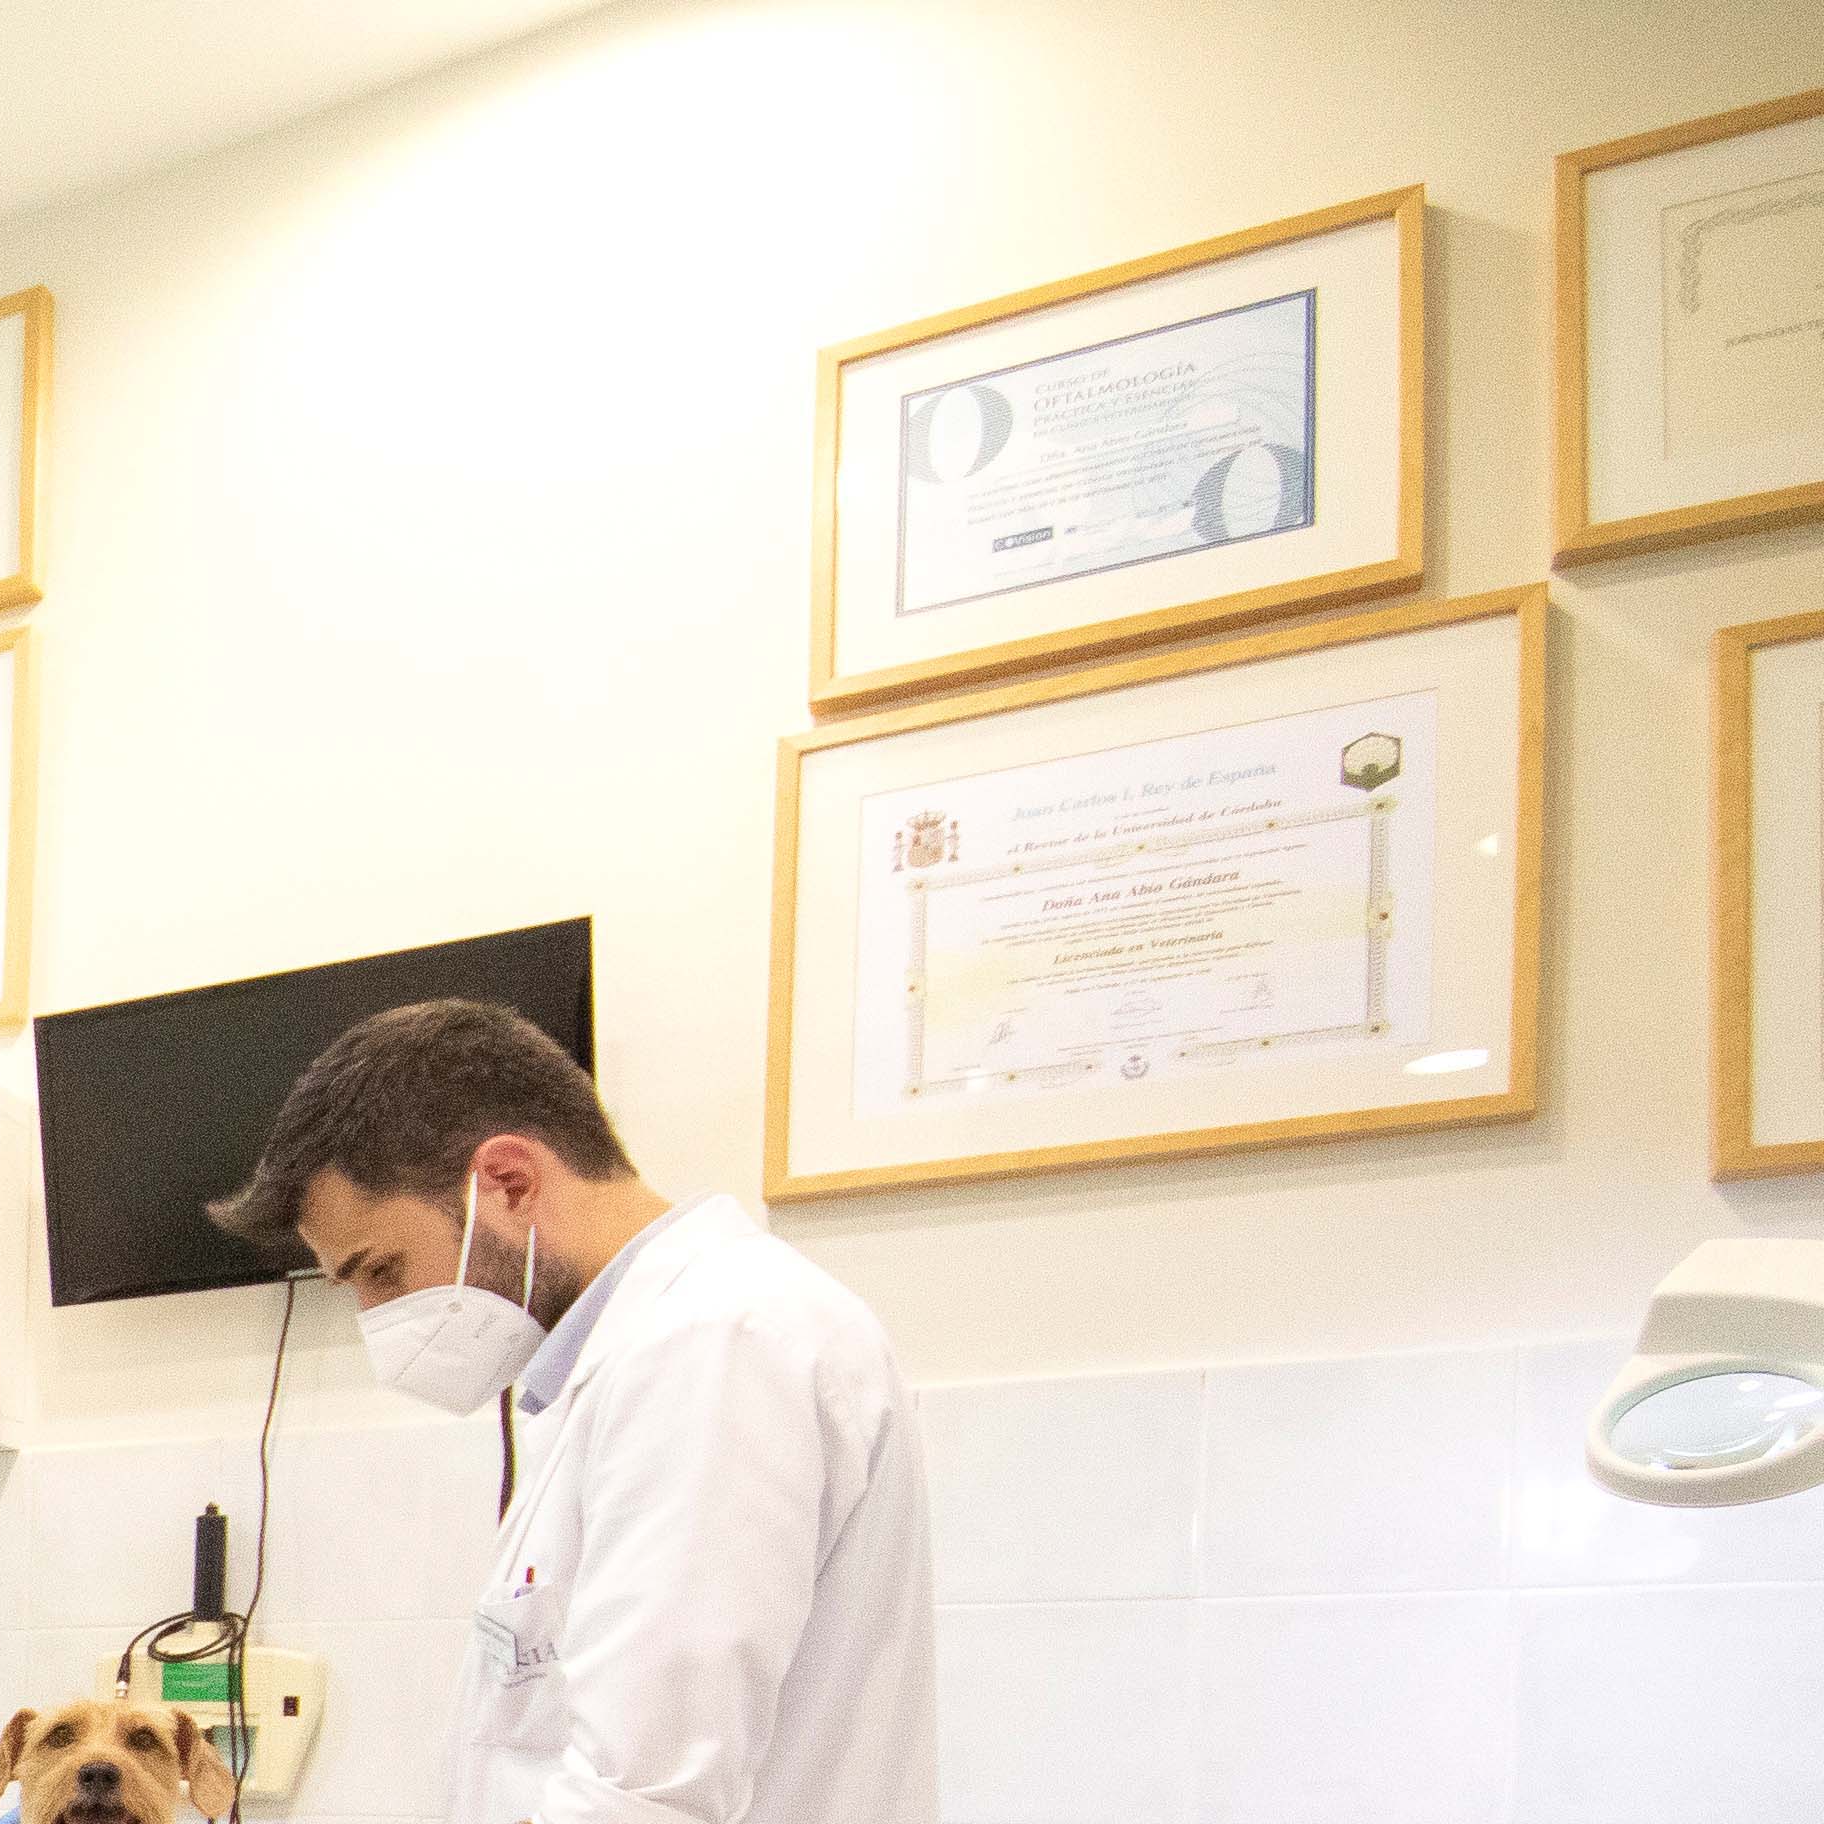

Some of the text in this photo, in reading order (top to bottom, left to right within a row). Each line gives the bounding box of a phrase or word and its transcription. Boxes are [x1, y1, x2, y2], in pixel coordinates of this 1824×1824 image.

[1032, 361, 1198, 412] OFTALMOLOGÍA
[1013, 803, 1054, 822] Juan
[1058, 793, 1117, 814] Carlos
[1140, 780, 1175, 799] Rey
[1179, 776, 1203, 791] de
[1207, 762, 1279, 787] España
[1072, 832, 1090, 844] de
[1112, 814, 1194, 836] Universidad
[1198, 810, 1216, 821] de
[1041, 896, 1083, 913] Doña
[1088, 889, 1121, 904] Ana
[1168, 870, 1241, 890] Gándara
